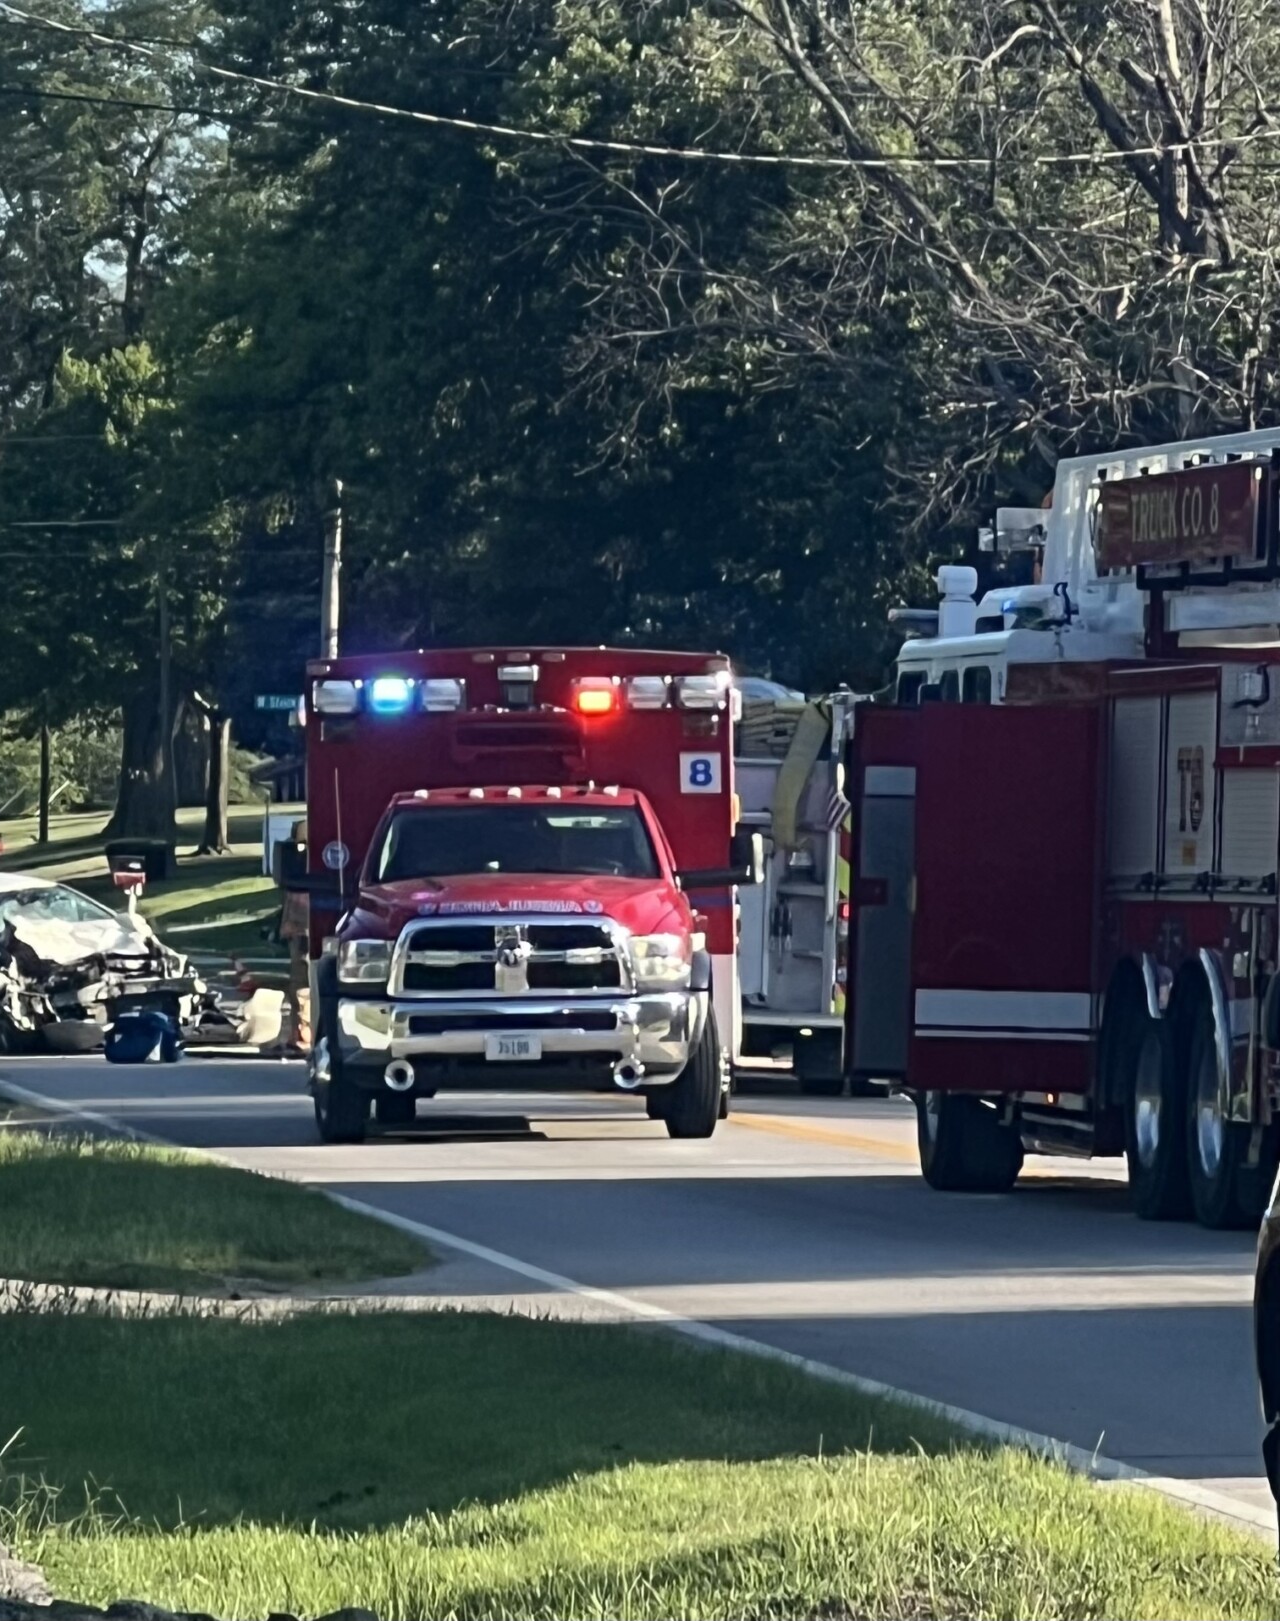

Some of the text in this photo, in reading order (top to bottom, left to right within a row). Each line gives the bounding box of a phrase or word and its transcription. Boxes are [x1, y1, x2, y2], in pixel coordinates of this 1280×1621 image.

[1131, 482, 1219, 543] TRUCK CO. 8
[689, 759, 713, 787] 8
